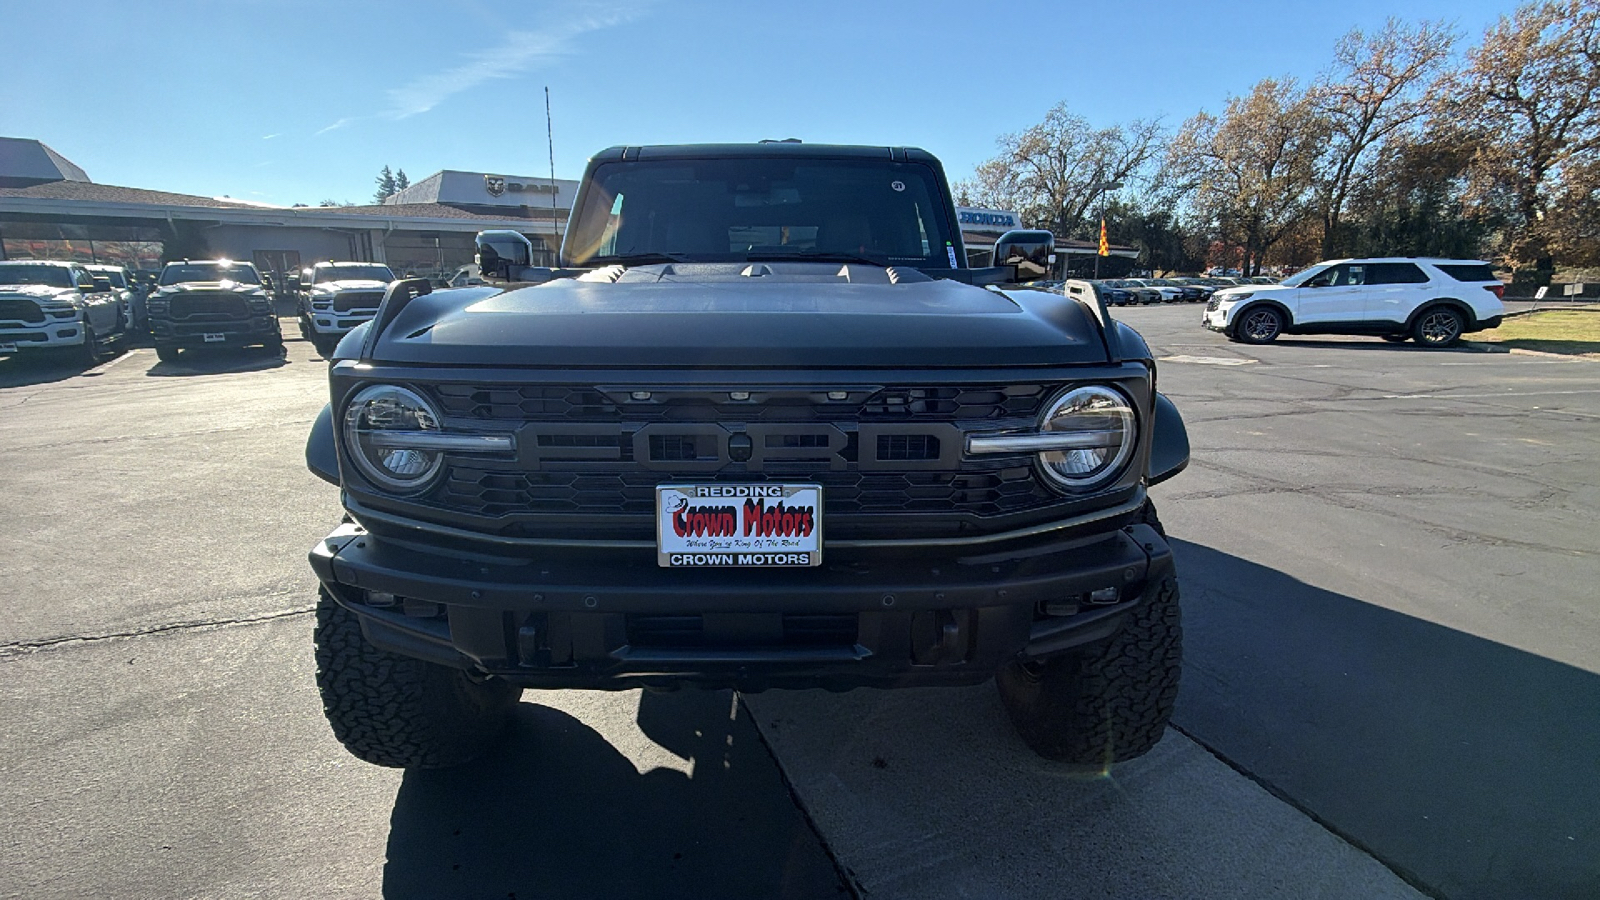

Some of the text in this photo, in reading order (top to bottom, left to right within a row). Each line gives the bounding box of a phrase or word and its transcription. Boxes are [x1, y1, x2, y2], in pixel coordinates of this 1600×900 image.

[959, 211, 1015, 227] HONDA
[518, 422, 959, 471] FORD
[697, 486, 782, 497] REDDING
[673, 498, 814, 538] Crown Motors
[686, 540, 708, 548] Where
[734, 540, 752, 549] King
[753, 540, 764, 549] Of
[766, 540, 779, 548] The
[781, 540, 800, 548] Road
[670, 553, 810, 566] CROWN MOTORS
